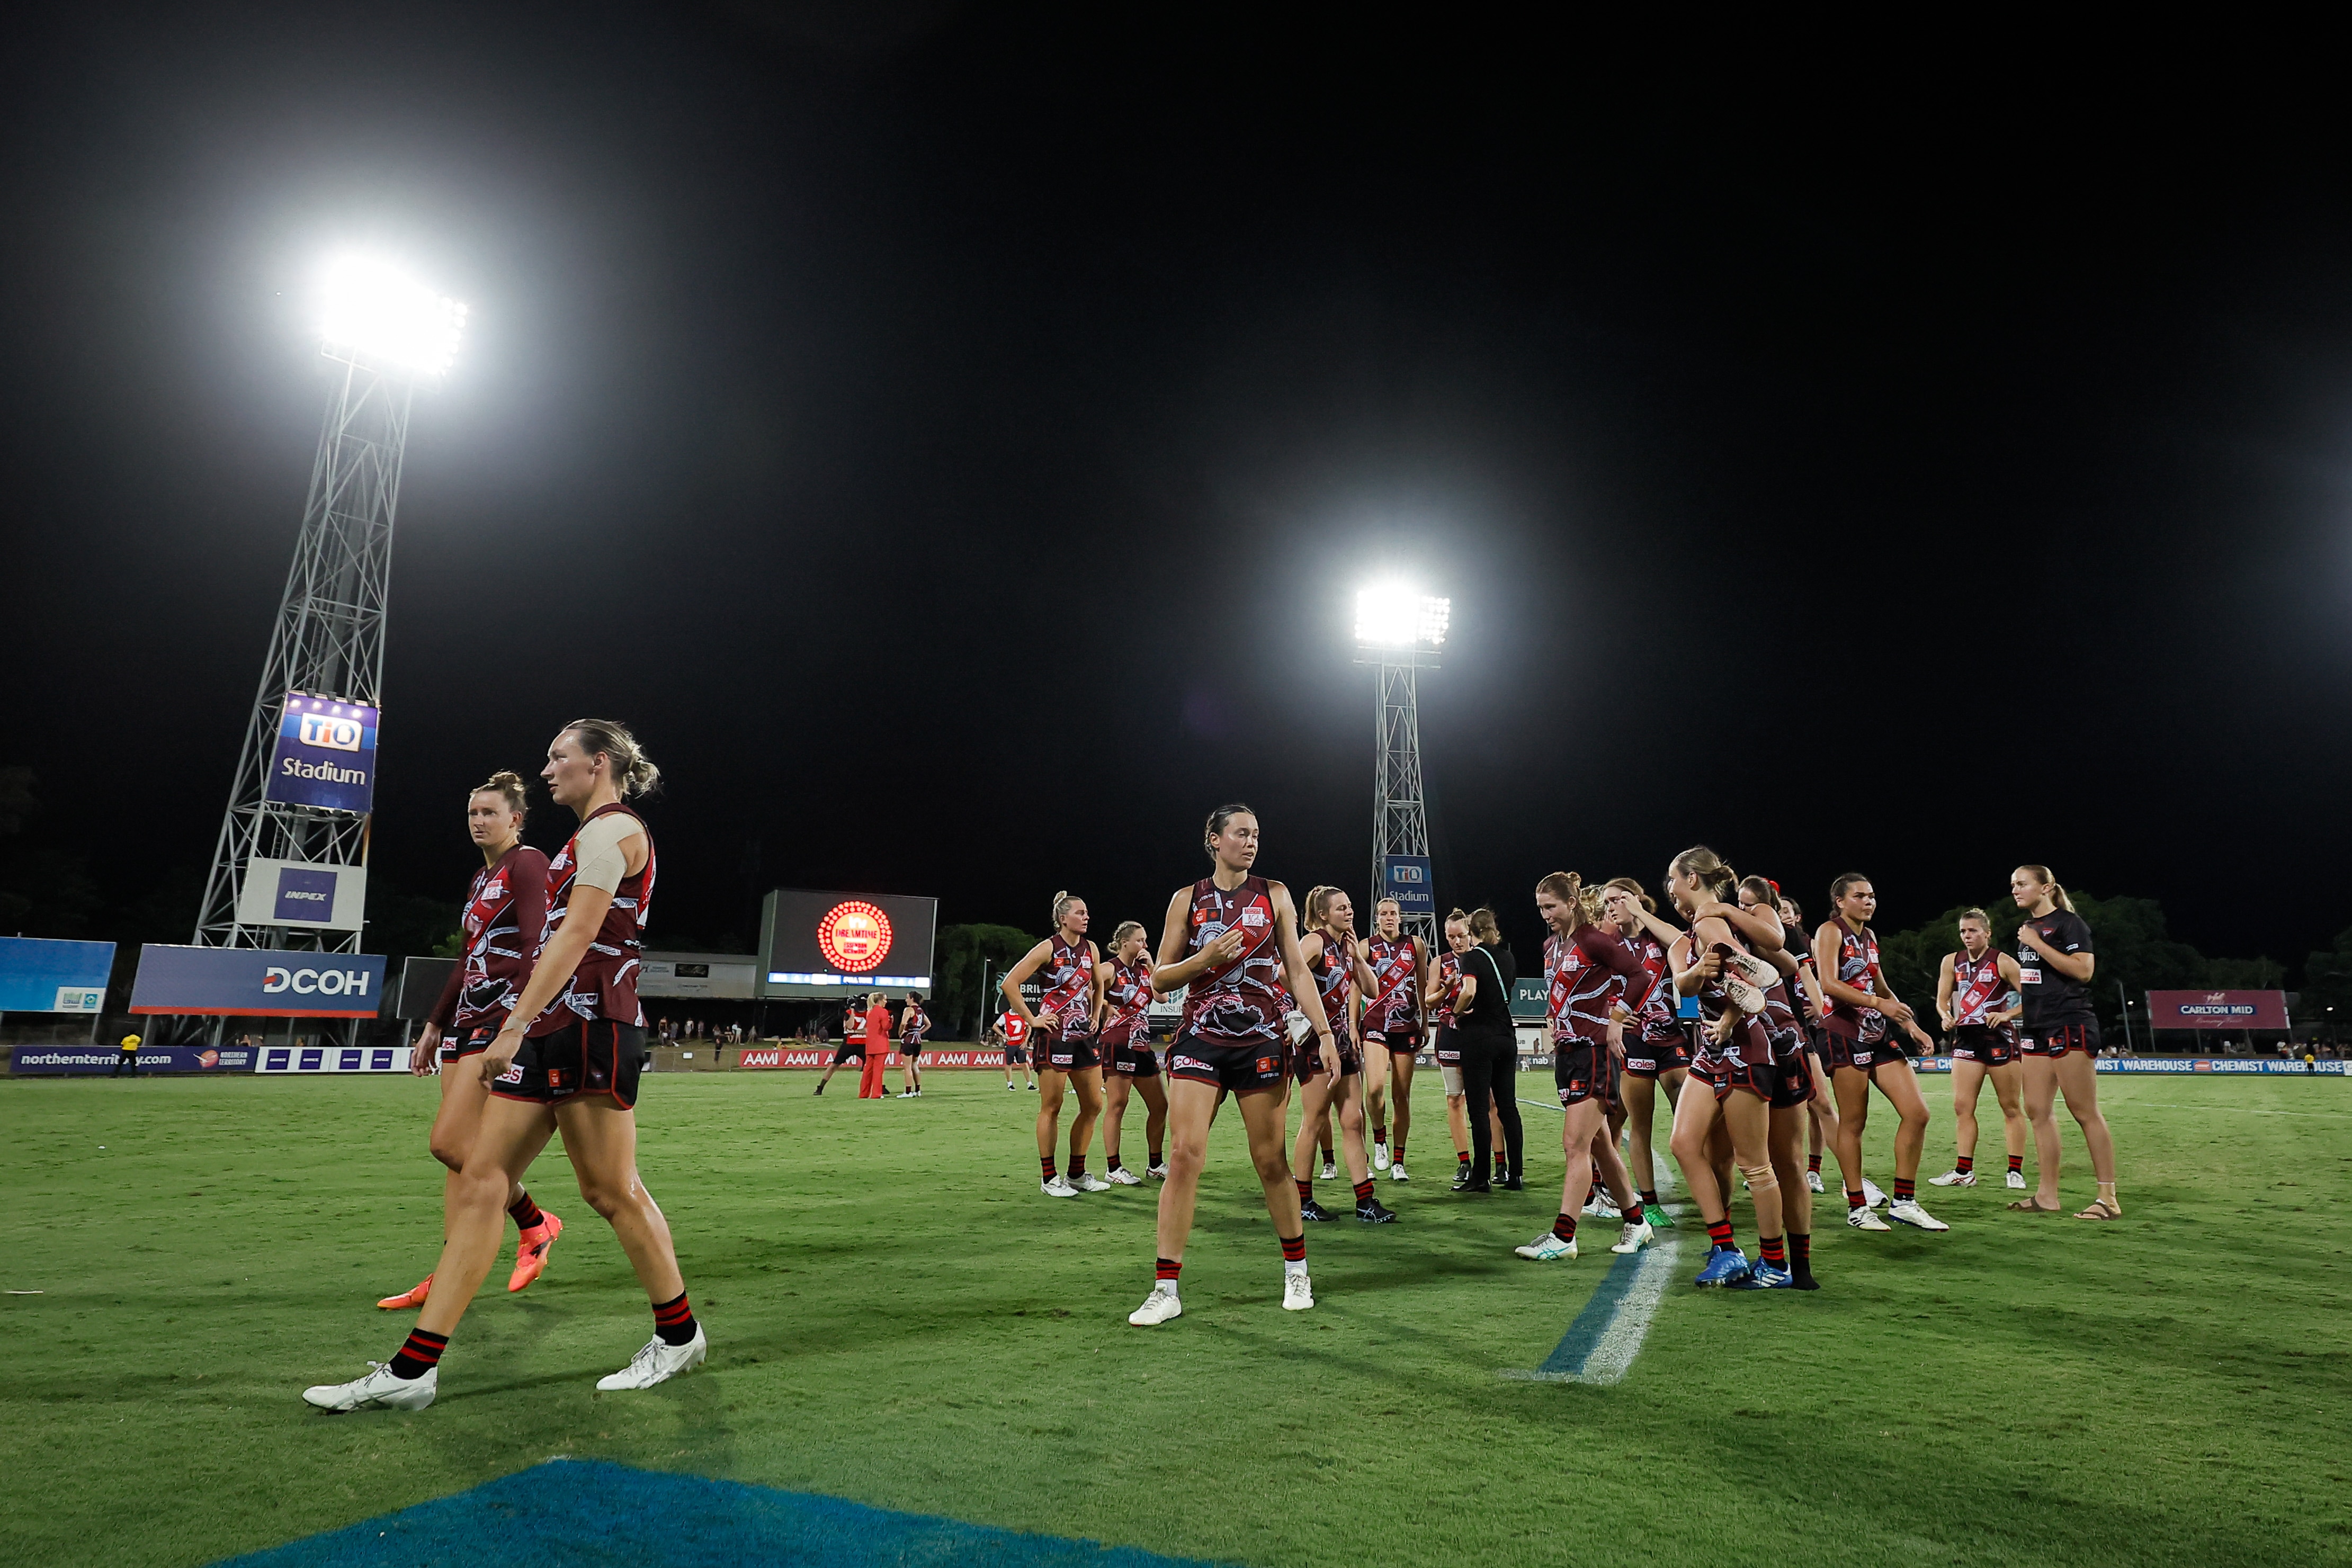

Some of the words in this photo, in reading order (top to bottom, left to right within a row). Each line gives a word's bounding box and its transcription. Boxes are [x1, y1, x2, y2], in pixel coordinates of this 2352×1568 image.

[281, 757, 365, 785] Stadium
[284, 891, 327, 901] INPEX
[1389, 890, 1429, 901] Stadium
[835, 928, 878, 939] DREAMTIME
[263, 967, 370, 996] DCOH
[2180, 1006, 2229, 1014] CARLTON
[854, 1016, 866, 1030] 7
[1010, 1020, 1023, 1034] 7
[743, 1053, 778, 1065] AAMI
[784, 1053, 819, 1065] AAMI
[937, 1053, 968, 1064] AAMI
[973, 1053, 1004, 1064] AAMI
[2122, 1061, 2193, 1071] WAREHOUSE
[2212, 1061, 2264, 1071] CHEMIST
